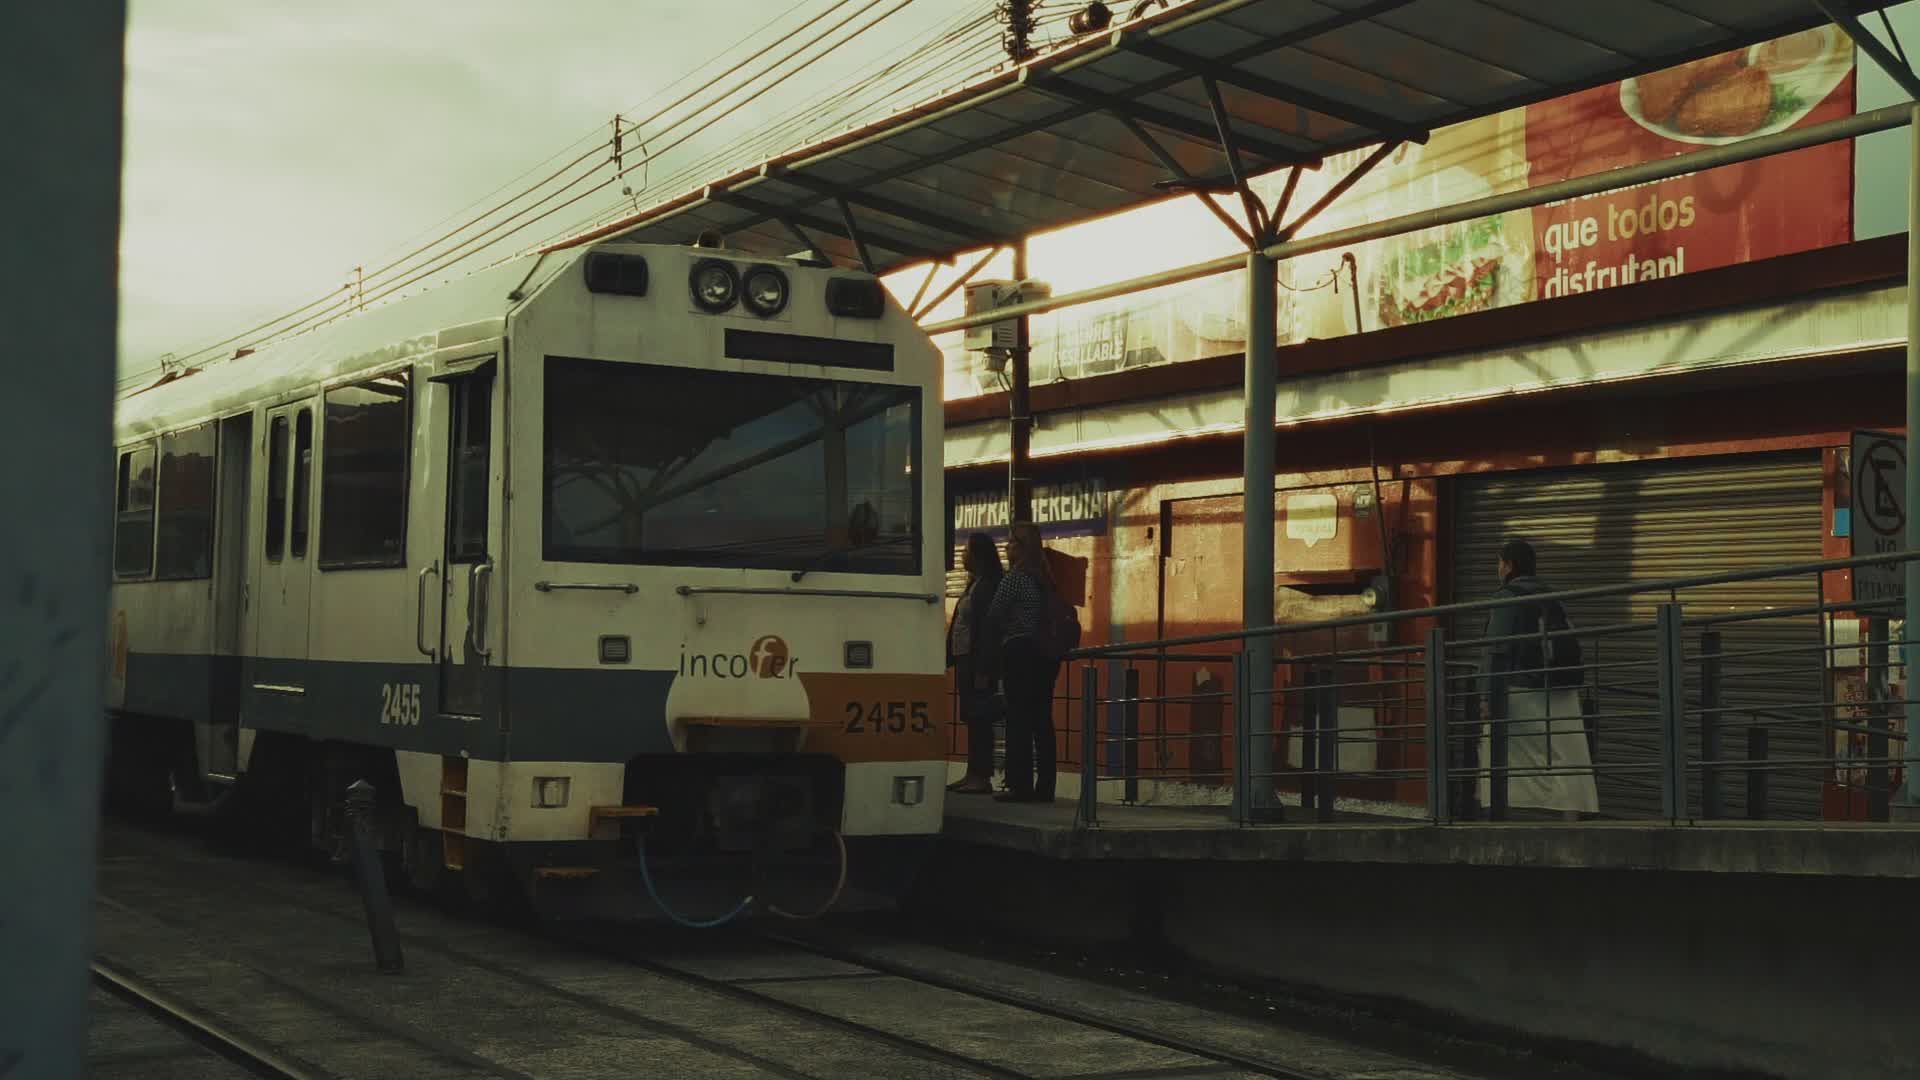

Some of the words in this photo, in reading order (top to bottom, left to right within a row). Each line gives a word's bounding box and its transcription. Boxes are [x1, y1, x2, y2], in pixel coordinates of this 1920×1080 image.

[1544, 217, 1599, 264] que
[1608, 194, 1696, 242] todos
[678, 636, 800, 680] incofer
[380, 683, 421, 726] 2455
[844, 700, 931, 734] 2455
